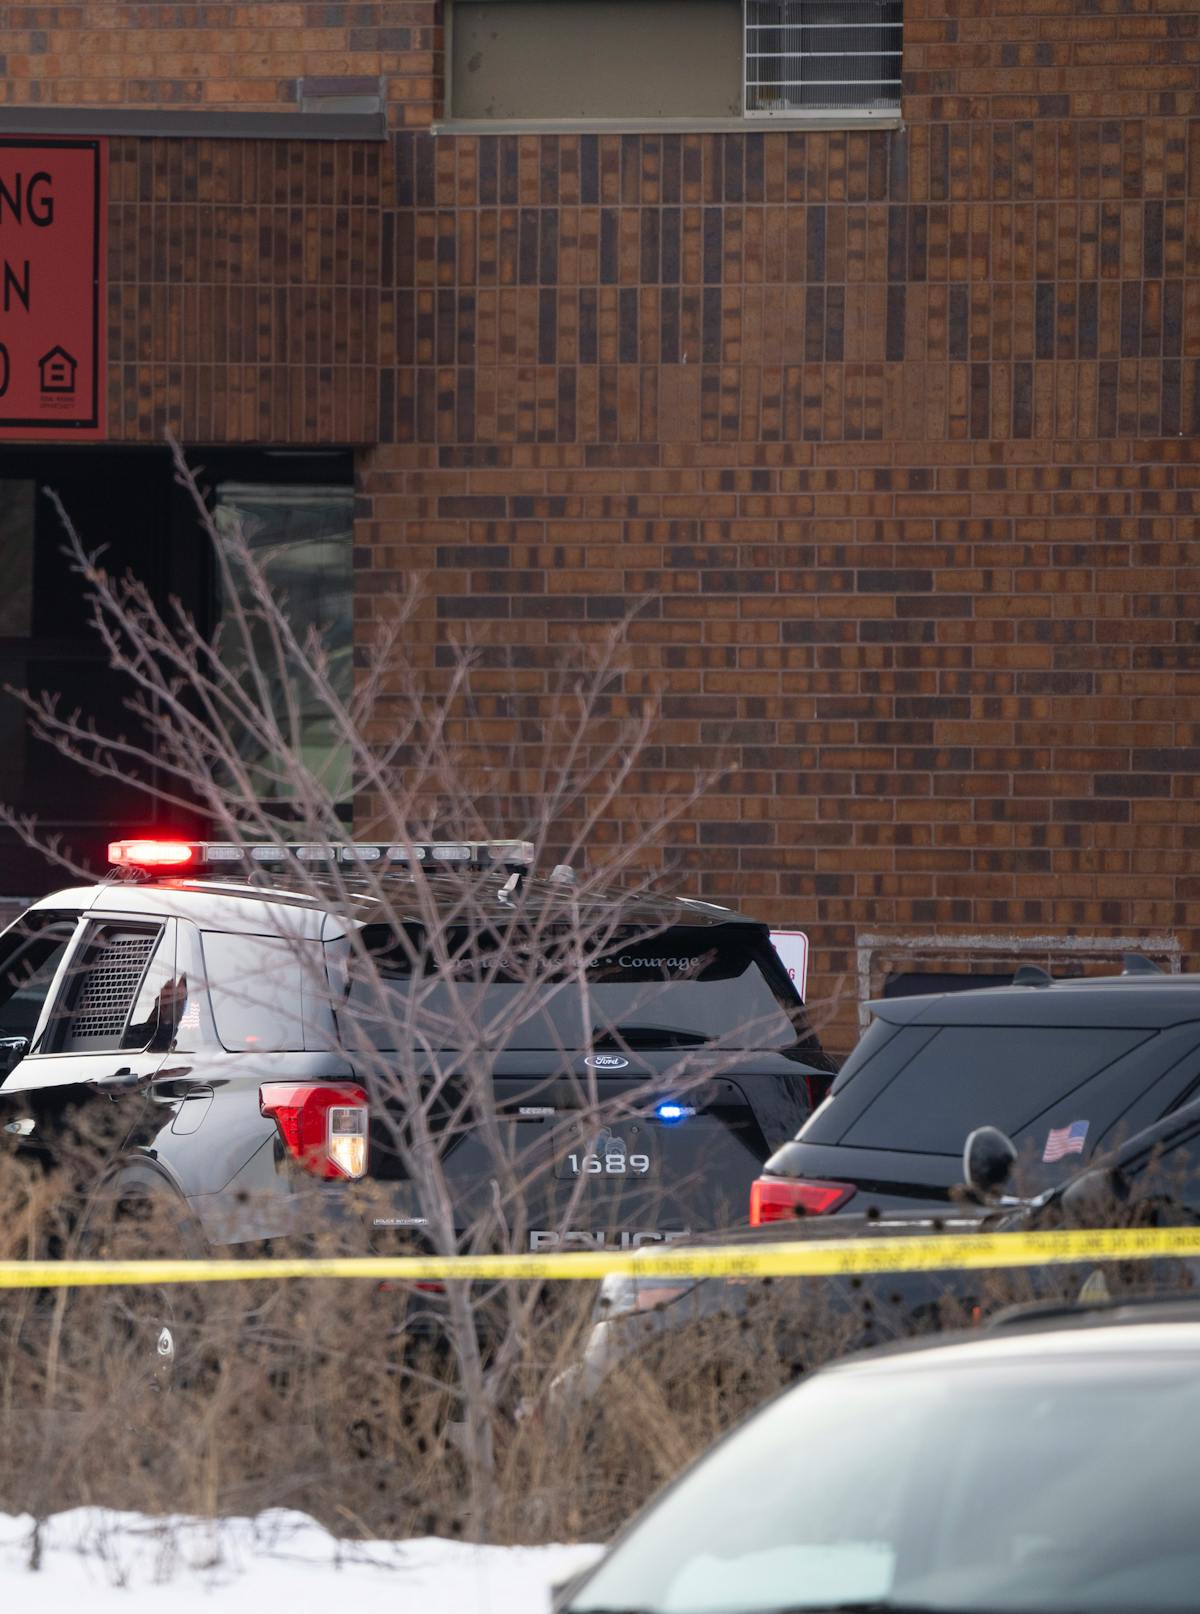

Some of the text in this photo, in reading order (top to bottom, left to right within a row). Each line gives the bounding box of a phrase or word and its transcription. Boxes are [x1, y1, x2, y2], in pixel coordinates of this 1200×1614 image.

[4, 260, 31, 313] N
[618, 955, 700, 970] Courage
[595, 1056, 619, 1065] Ford
[568, 1154, 650, 1173] 1689
